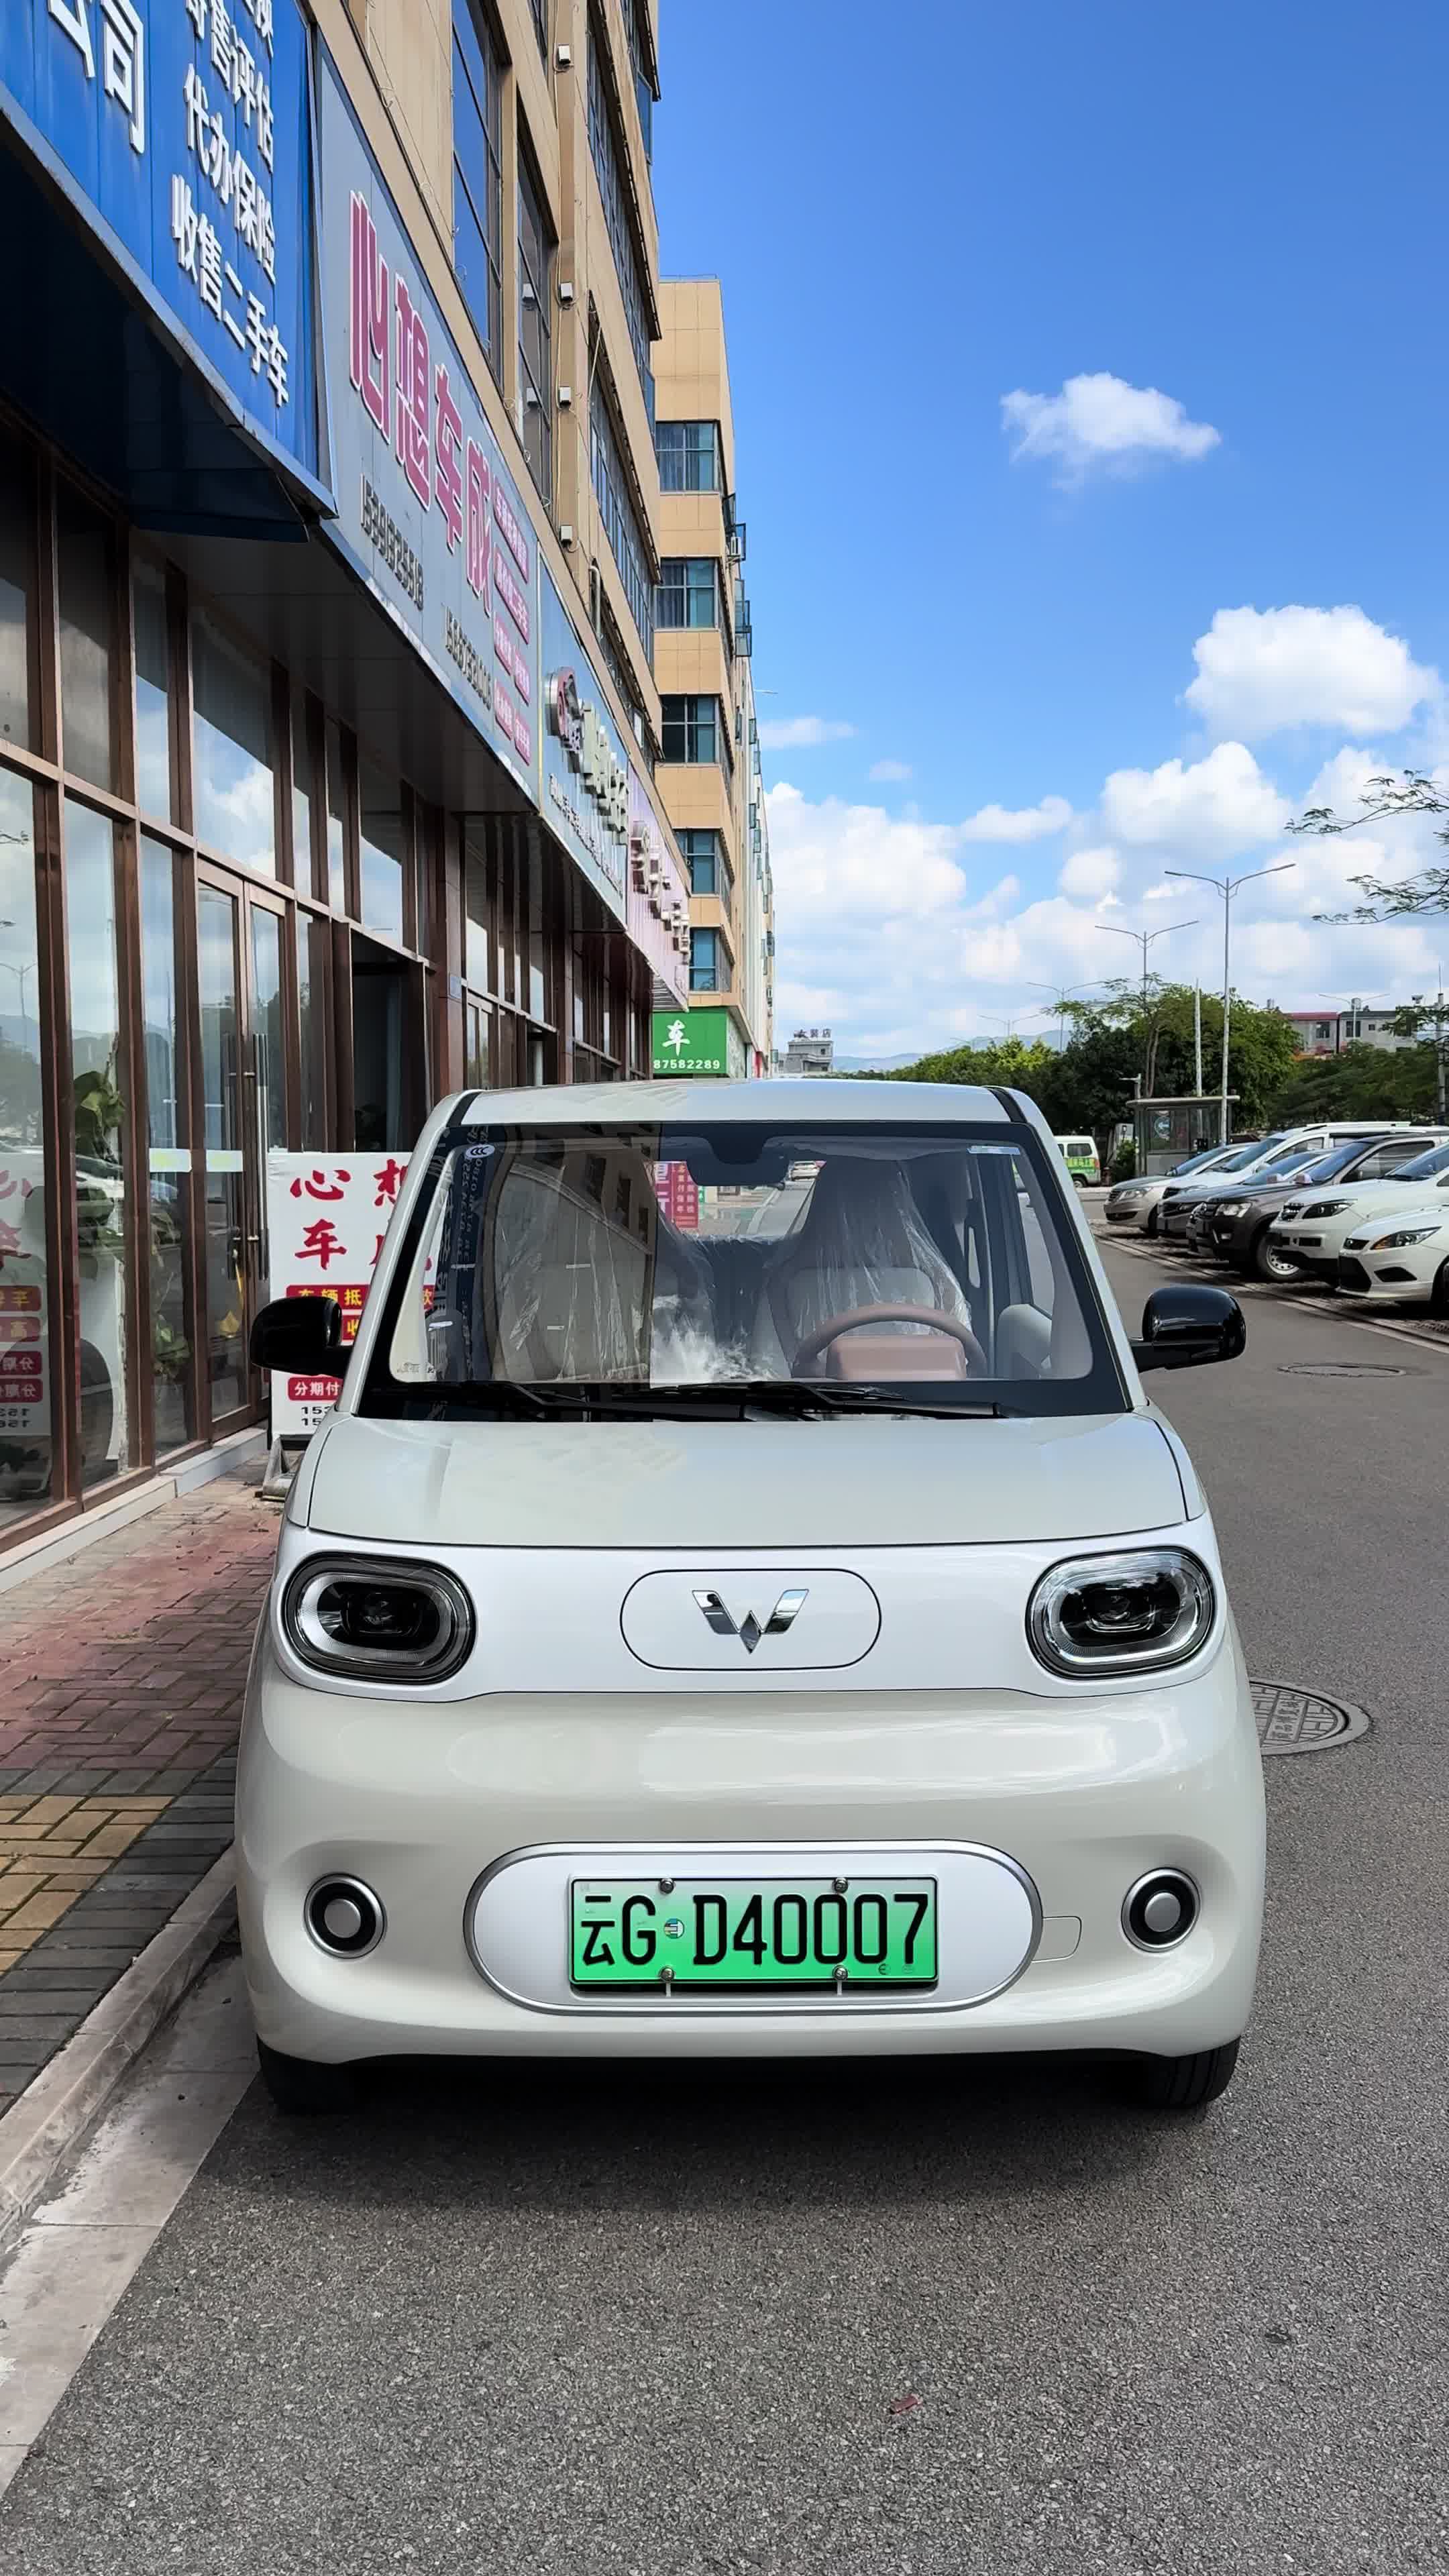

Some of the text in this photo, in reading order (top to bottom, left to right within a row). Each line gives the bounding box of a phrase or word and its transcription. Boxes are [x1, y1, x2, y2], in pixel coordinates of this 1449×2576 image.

[184, 62, 276, 284] 代办保险
[172, 173, 289, 408] 收售二手车
[653, 1059, 720, 1070] 87582289
[692, 1894, 929, 1966] D40007
